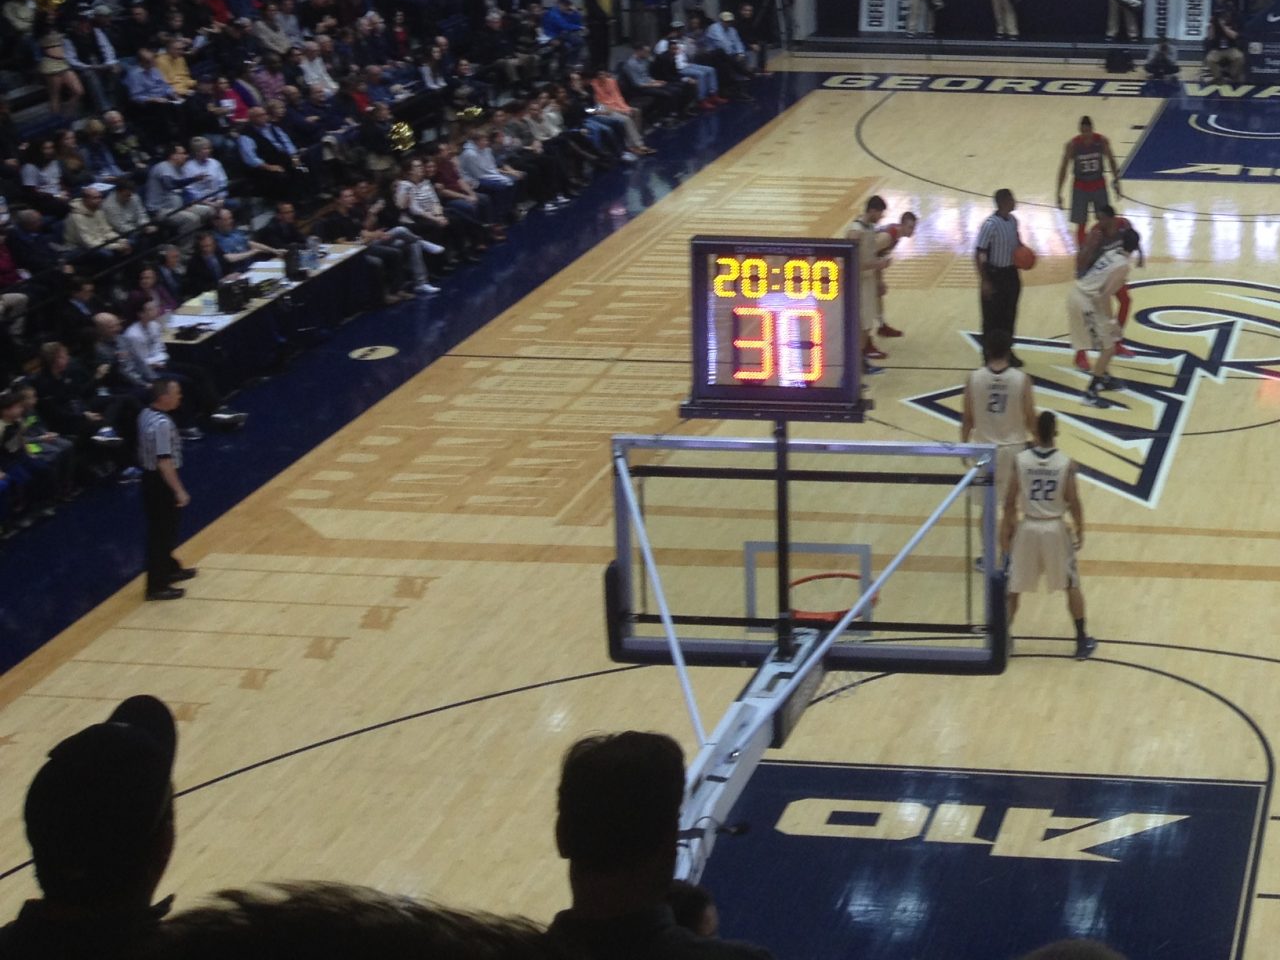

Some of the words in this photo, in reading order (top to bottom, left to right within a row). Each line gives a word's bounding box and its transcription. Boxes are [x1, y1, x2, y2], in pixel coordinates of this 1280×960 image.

[820, 74, 1147, 98] GEORGE
[712, 257, 841, 302] 20:00
[732, 305, 825, 383] 30
[1030, 478, 1057, 501] 22
[774, 798, 1192, 863] A10
